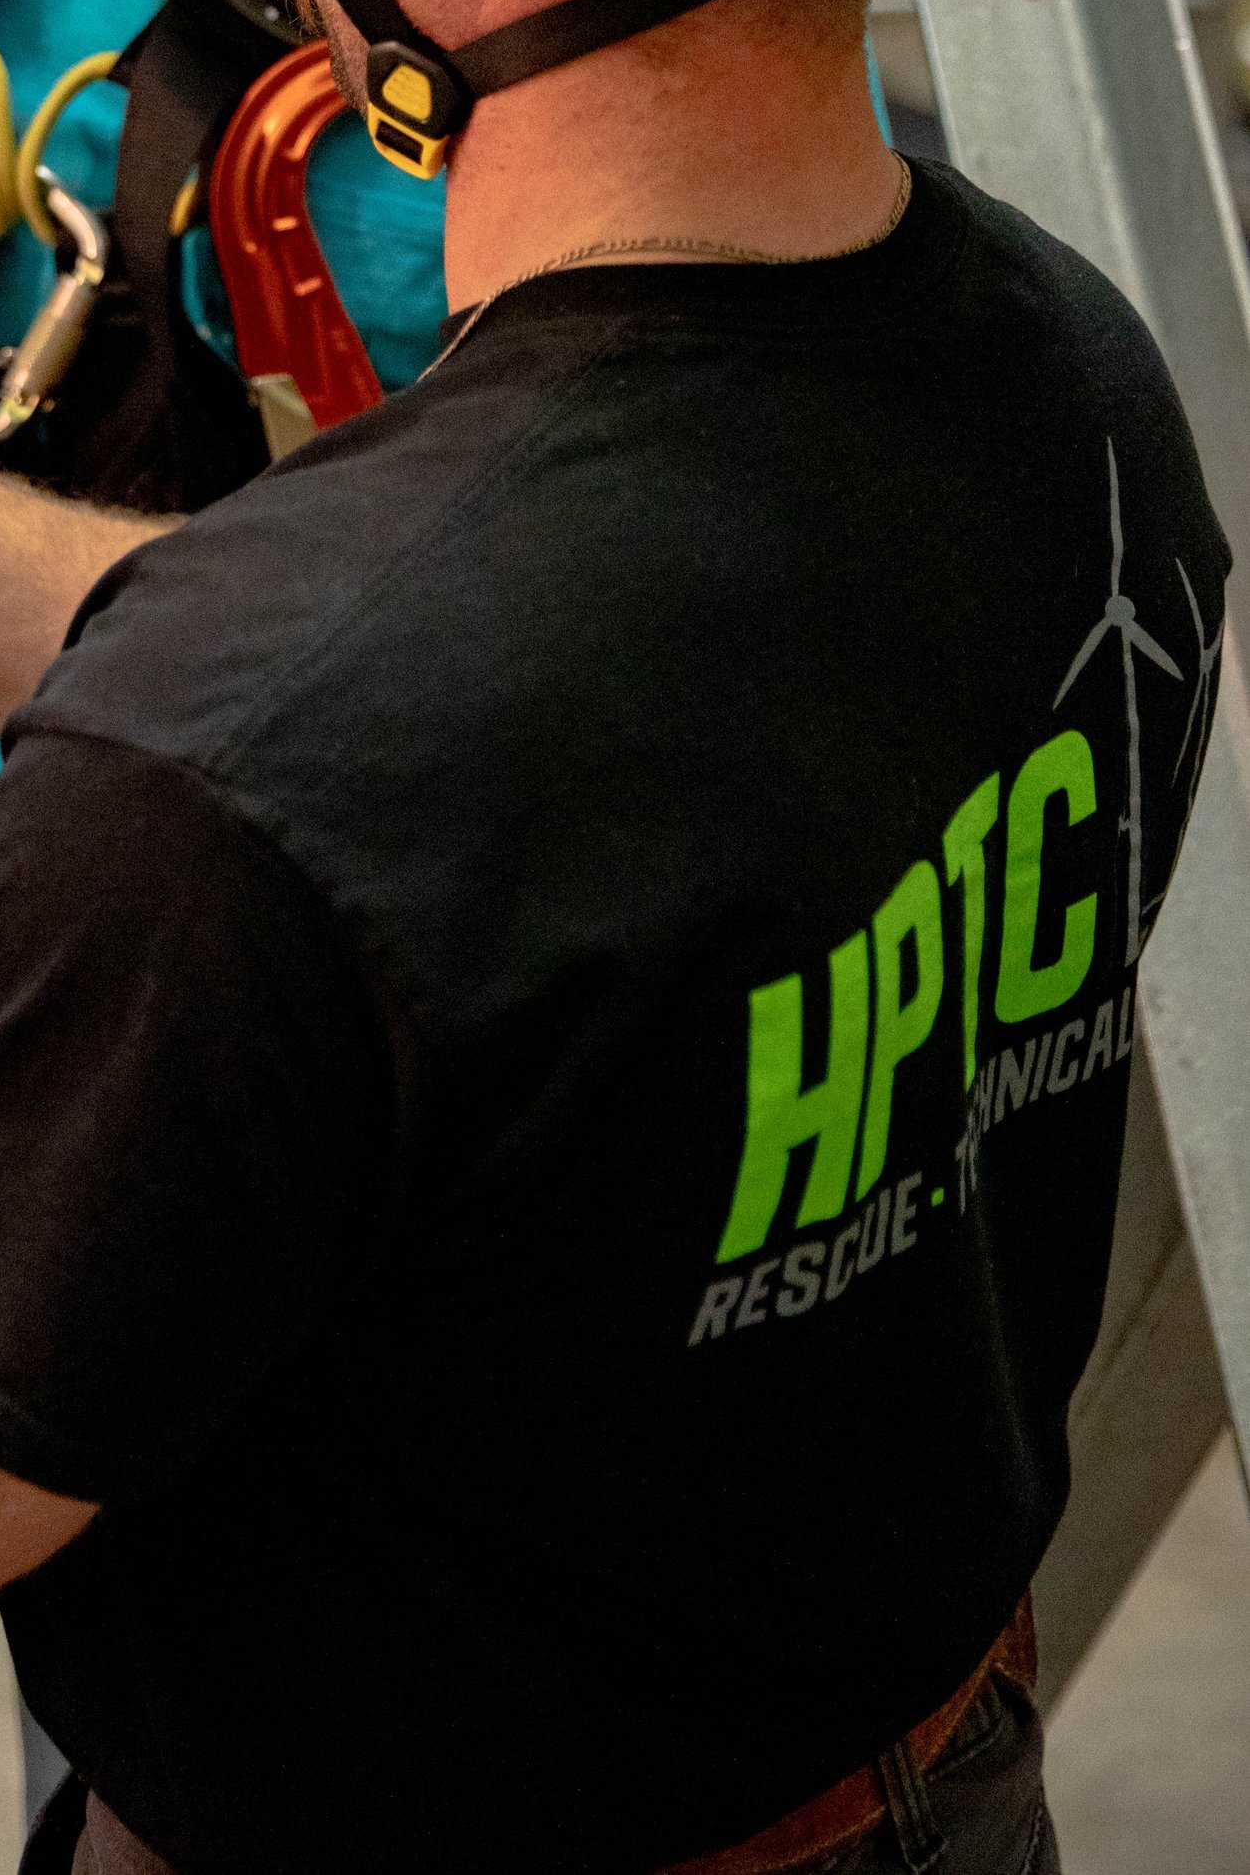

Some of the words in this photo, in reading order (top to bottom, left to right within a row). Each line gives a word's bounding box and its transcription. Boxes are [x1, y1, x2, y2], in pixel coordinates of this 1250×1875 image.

[686, 1171, 924, 1349] RESCUE
[955, 986, 1132, 1217] THNICAL
[716, 729, 1098, 1264] HPTC
